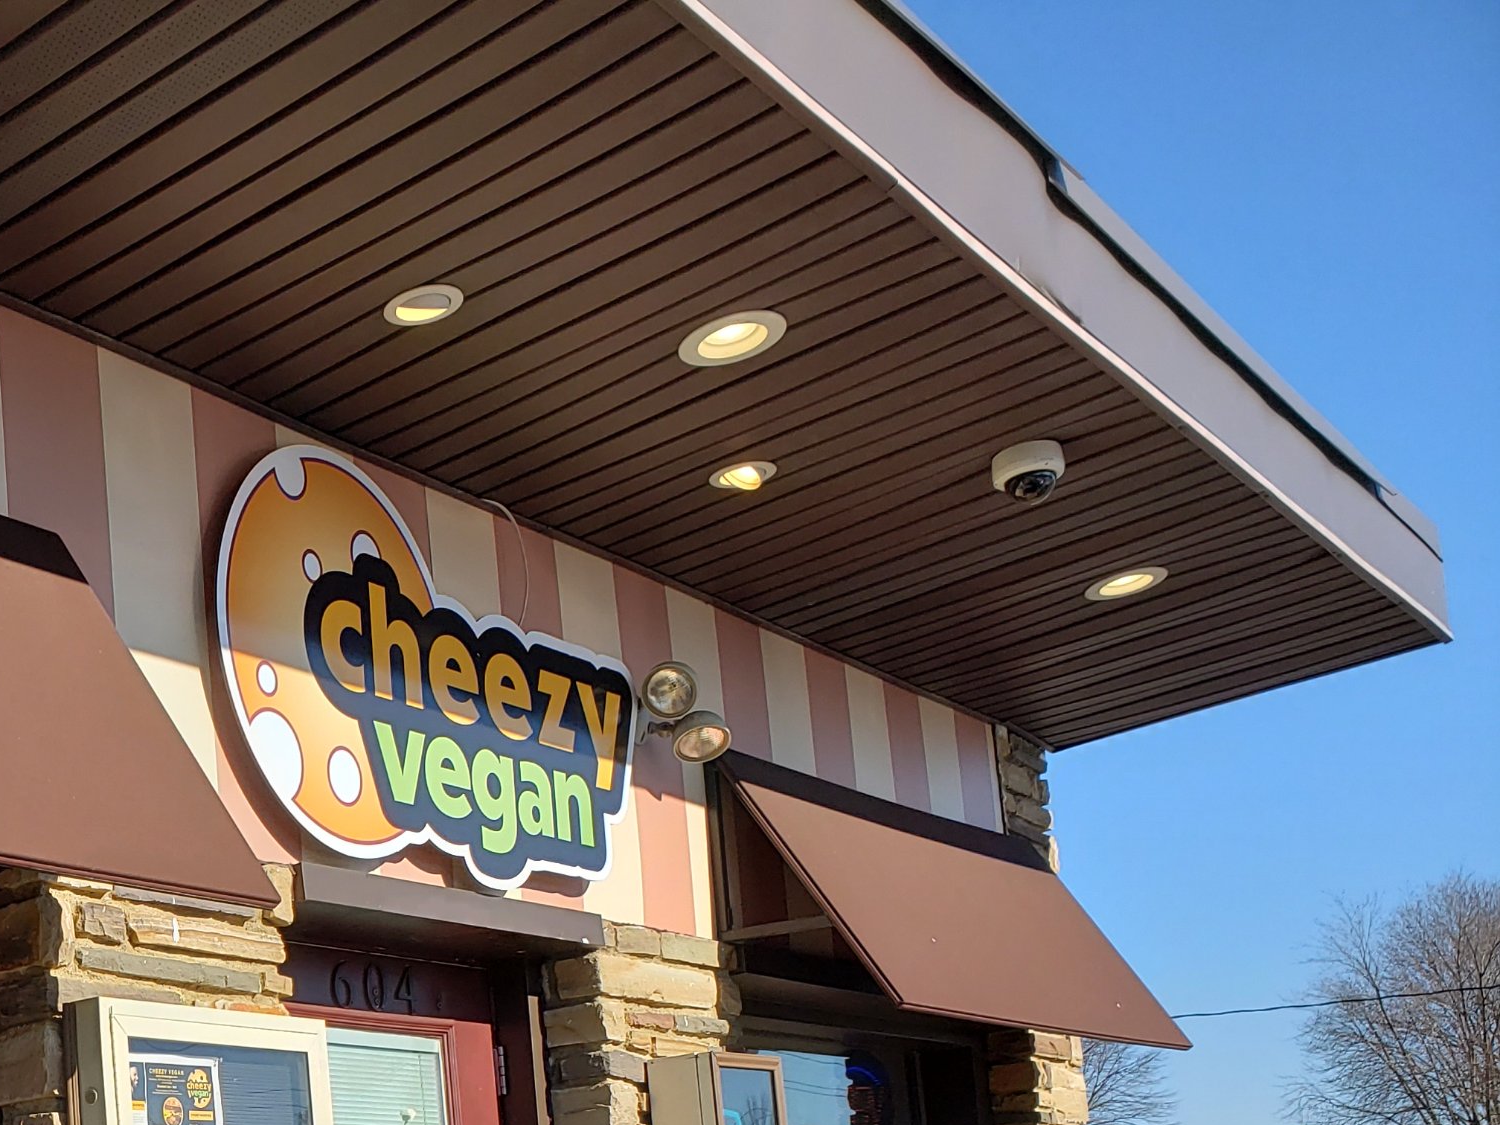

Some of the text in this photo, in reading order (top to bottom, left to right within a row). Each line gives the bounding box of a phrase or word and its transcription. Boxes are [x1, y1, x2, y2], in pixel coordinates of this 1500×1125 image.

[320, 582, 621, 791] cheezy
[373, 720, 596, 854] vegan
[330, 960, 413, 1016] 604
